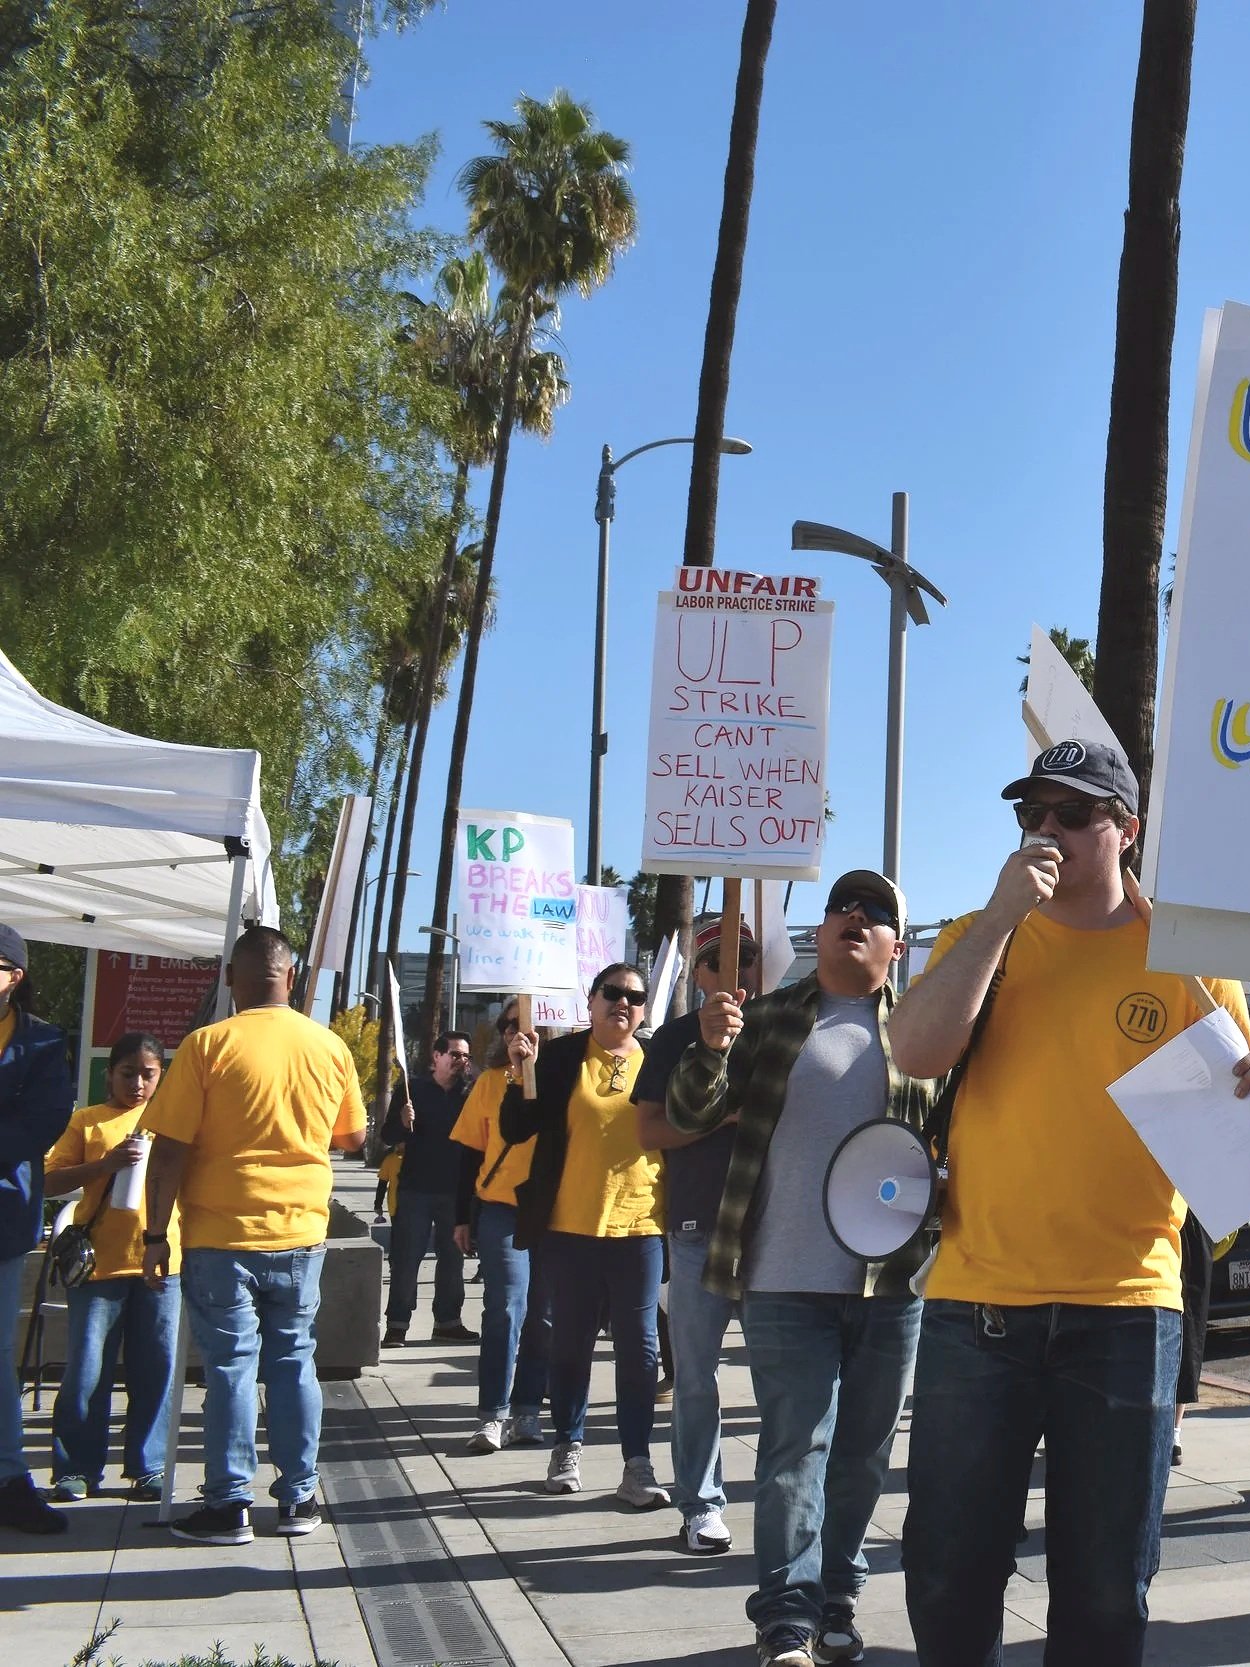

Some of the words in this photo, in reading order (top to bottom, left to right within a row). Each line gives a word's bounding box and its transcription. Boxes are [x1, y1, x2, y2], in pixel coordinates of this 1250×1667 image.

[679, 569, 816, 597] UNFAIR
[676, 595, 714, 608] LABOR
[717, 598, 772, 611] PRACTICE
[774, 599, 816, 612] STRIKE
[678, 614, 802, 687] ULP
[669, 686, 806, 718] STRIKE
[694, 723, 776, 748] CAN'T
[652, 753, 725, 779] SELL
[738, 757, 820, 784] WHEN
[1049, 748, 1078, 762] 770
[685, 780, 783, 809] KAISER
[466, 824, 525, 862] KP
[653, 811, 747, 847] SELLS
[760, 816, 821, 845] OUT!
[468, 863, 574, 897] BREAKS
[467, 893, 529, 916] THE
[533, 901, 574, 920] LAW
[535, 1001, 567, 1021] the
[1128, 1004, 1158, 1032] 770
